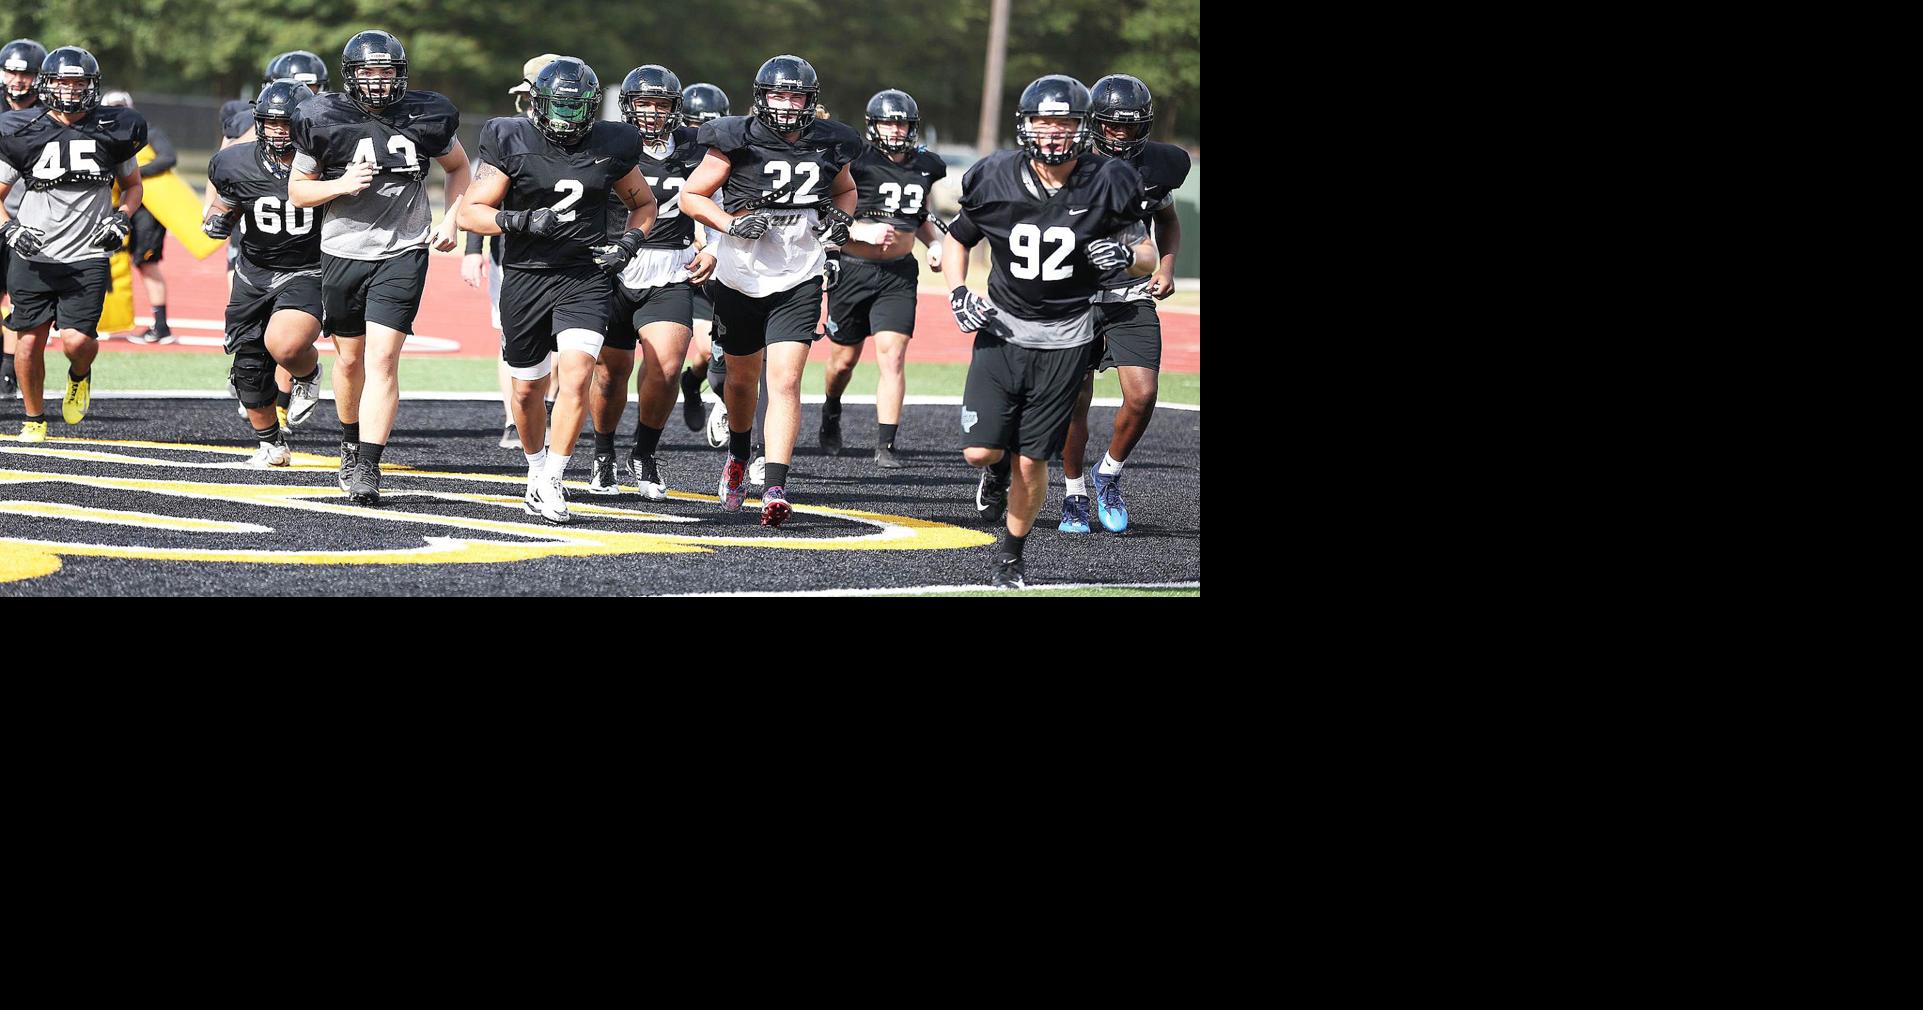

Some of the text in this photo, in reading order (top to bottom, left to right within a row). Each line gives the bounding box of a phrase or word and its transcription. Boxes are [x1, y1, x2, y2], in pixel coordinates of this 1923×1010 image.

[32, 140, 101, 180] 45
[551, 179, 584, 222] 2
[762, 160, 820, 204] 32
[879, 182, 924, 214] 33
[253, 196, 314, 235] 60
[1009, 223, 1076, 281] 92
